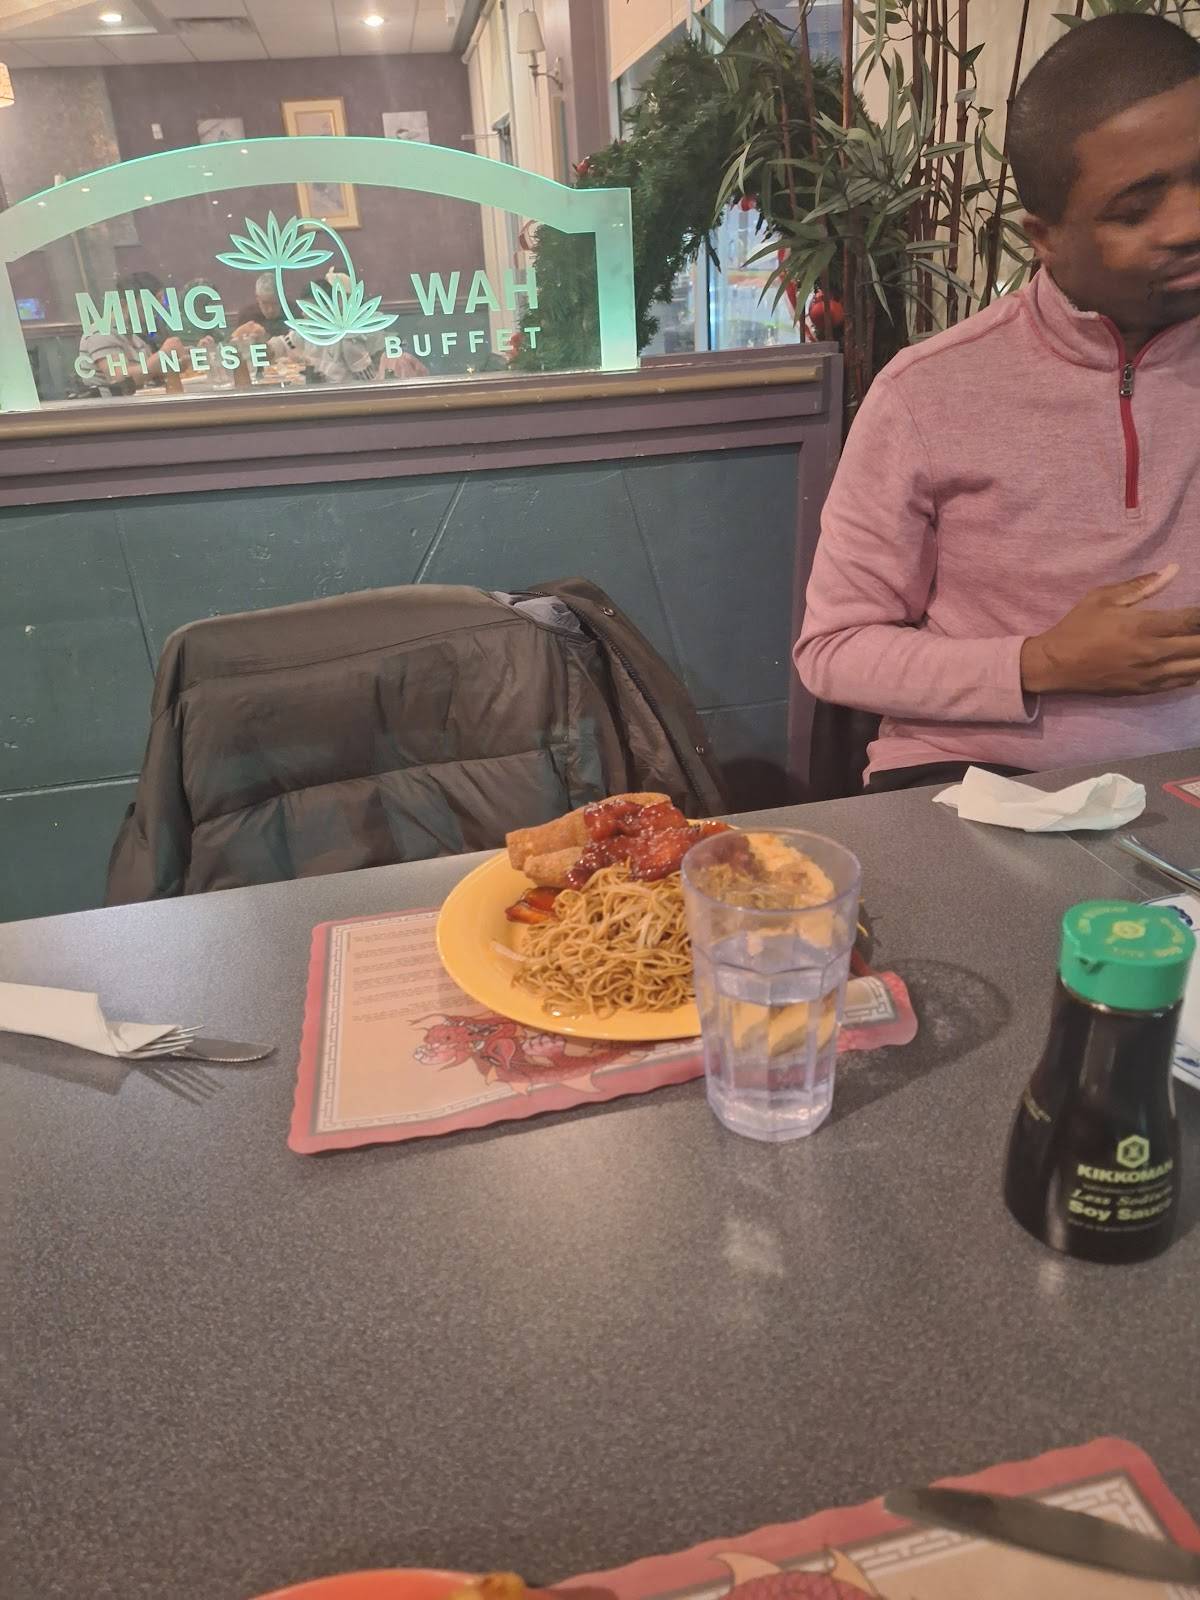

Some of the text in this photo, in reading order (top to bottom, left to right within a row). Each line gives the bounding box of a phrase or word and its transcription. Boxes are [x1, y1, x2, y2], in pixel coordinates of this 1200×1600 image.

[75, 269, 539, 336] MING WAH
[74, 326, 541, 379] CHINESE BUFFET
[1077, 1158, 1173, 1183] KIKKOMAN
[1068, 1200, 1112, 1221] Soy
